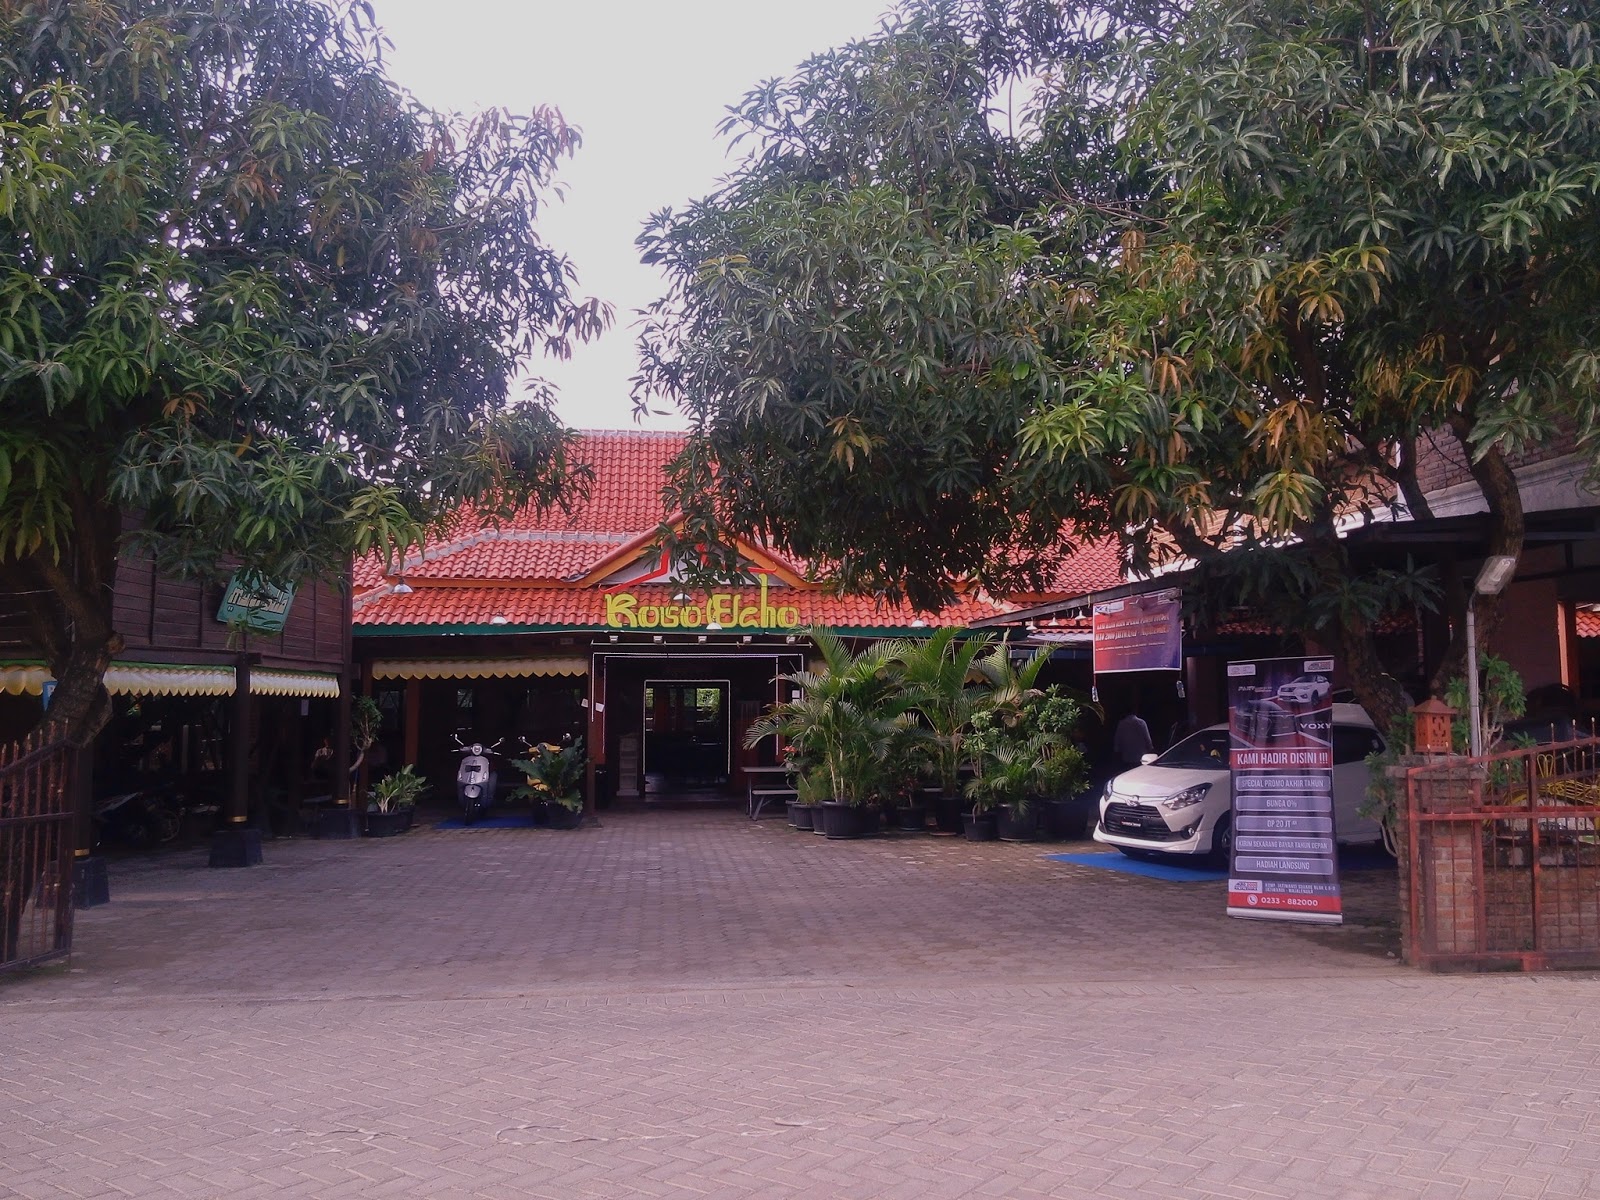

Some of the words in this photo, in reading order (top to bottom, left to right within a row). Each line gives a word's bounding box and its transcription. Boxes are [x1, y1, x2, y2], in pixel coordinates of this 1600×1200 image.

[605, 593, 700, 628] Roso
[706, 573, 800, 628] Echo
[1237, 753, 1259, 765] KAMI
[1261, 752, 1288, 764] HADIR
[1290, 752, 1317, 764] DISINI
[1319, 752, 1329, 764] !!!
[1242, 779, 1264, 788] SPECIAL
[1264, 779, 1285, 788] PROMO
[1285, 779, 1304, 788] AKHIR
[1304, 779, 1324, 788] TAHUN
[1266, 799, 1286, 808] BUNGA
[1286, 800, 1297, 808] 0%
[1267, 819, 1275, 828] DP
[1275, 820, 1284, 828] 20
[1284, 820, 1291, 828] JT
[1253, 840, 1278, 848] SEKARANG
[1278, 840, 1295, 849] BAYAR
[1294, 841, 1311, 849] TAHUN
[1256, 860, 1278, 869] HADIAH
[1279, 861, 1310, 870] LANGSUNG
[1261, 896, 1281, 905] 0233
[1287, 898, 1319, 907] 882000
